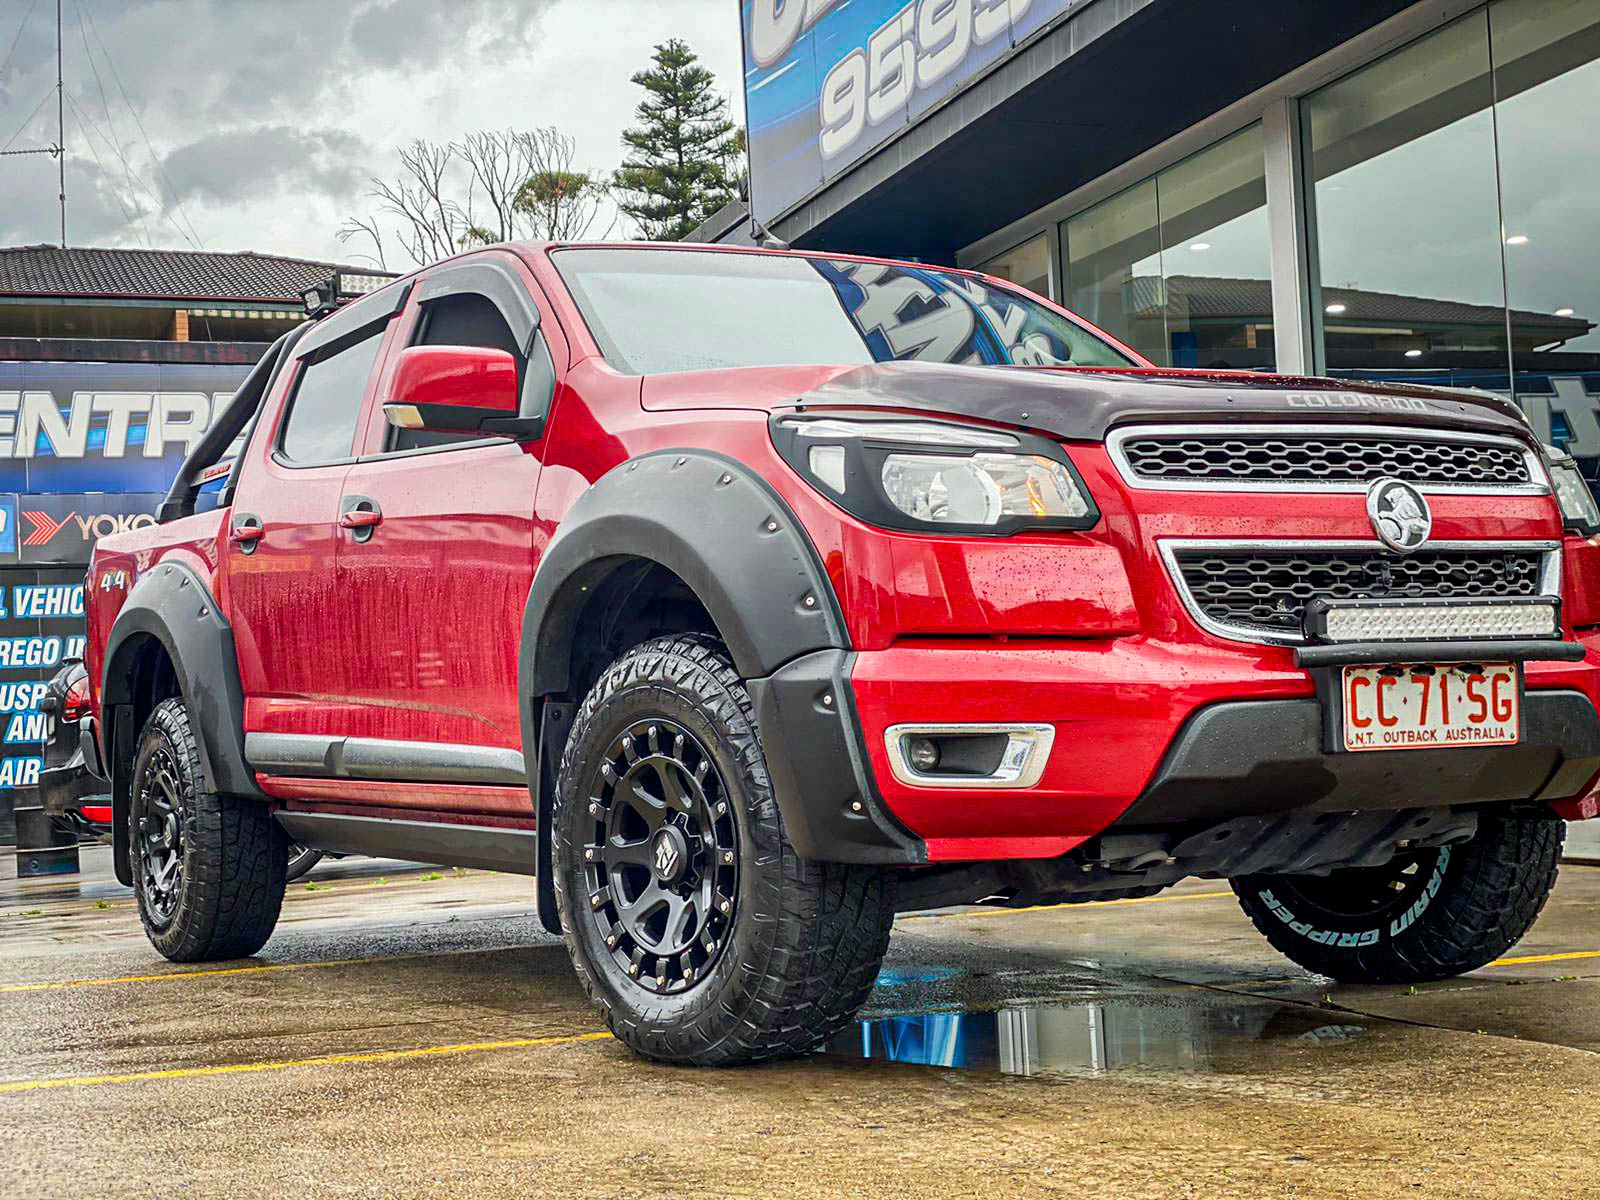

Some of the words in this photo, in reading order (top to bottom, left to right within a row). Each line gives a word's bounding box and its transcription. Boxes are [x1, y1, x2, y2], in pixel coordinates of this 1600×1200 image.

[1285, 393, 1428, 412] COLORADO
[0, 638, 60, 666] REGO
[1350, 676, 1398, 728] CC
[1411, 672, 1449, 726] 71
[1466, 673, 1512, 724] SG
[1355, 731, 1375, 745] N.T.
[1383, 729, 1438, 744] OUTBACK
[1445, 727, 1506, 741] AUSTRALIA
[0, 758, 40, 786] AIR
[1258, 889, 1380, 947] GRIPPER
